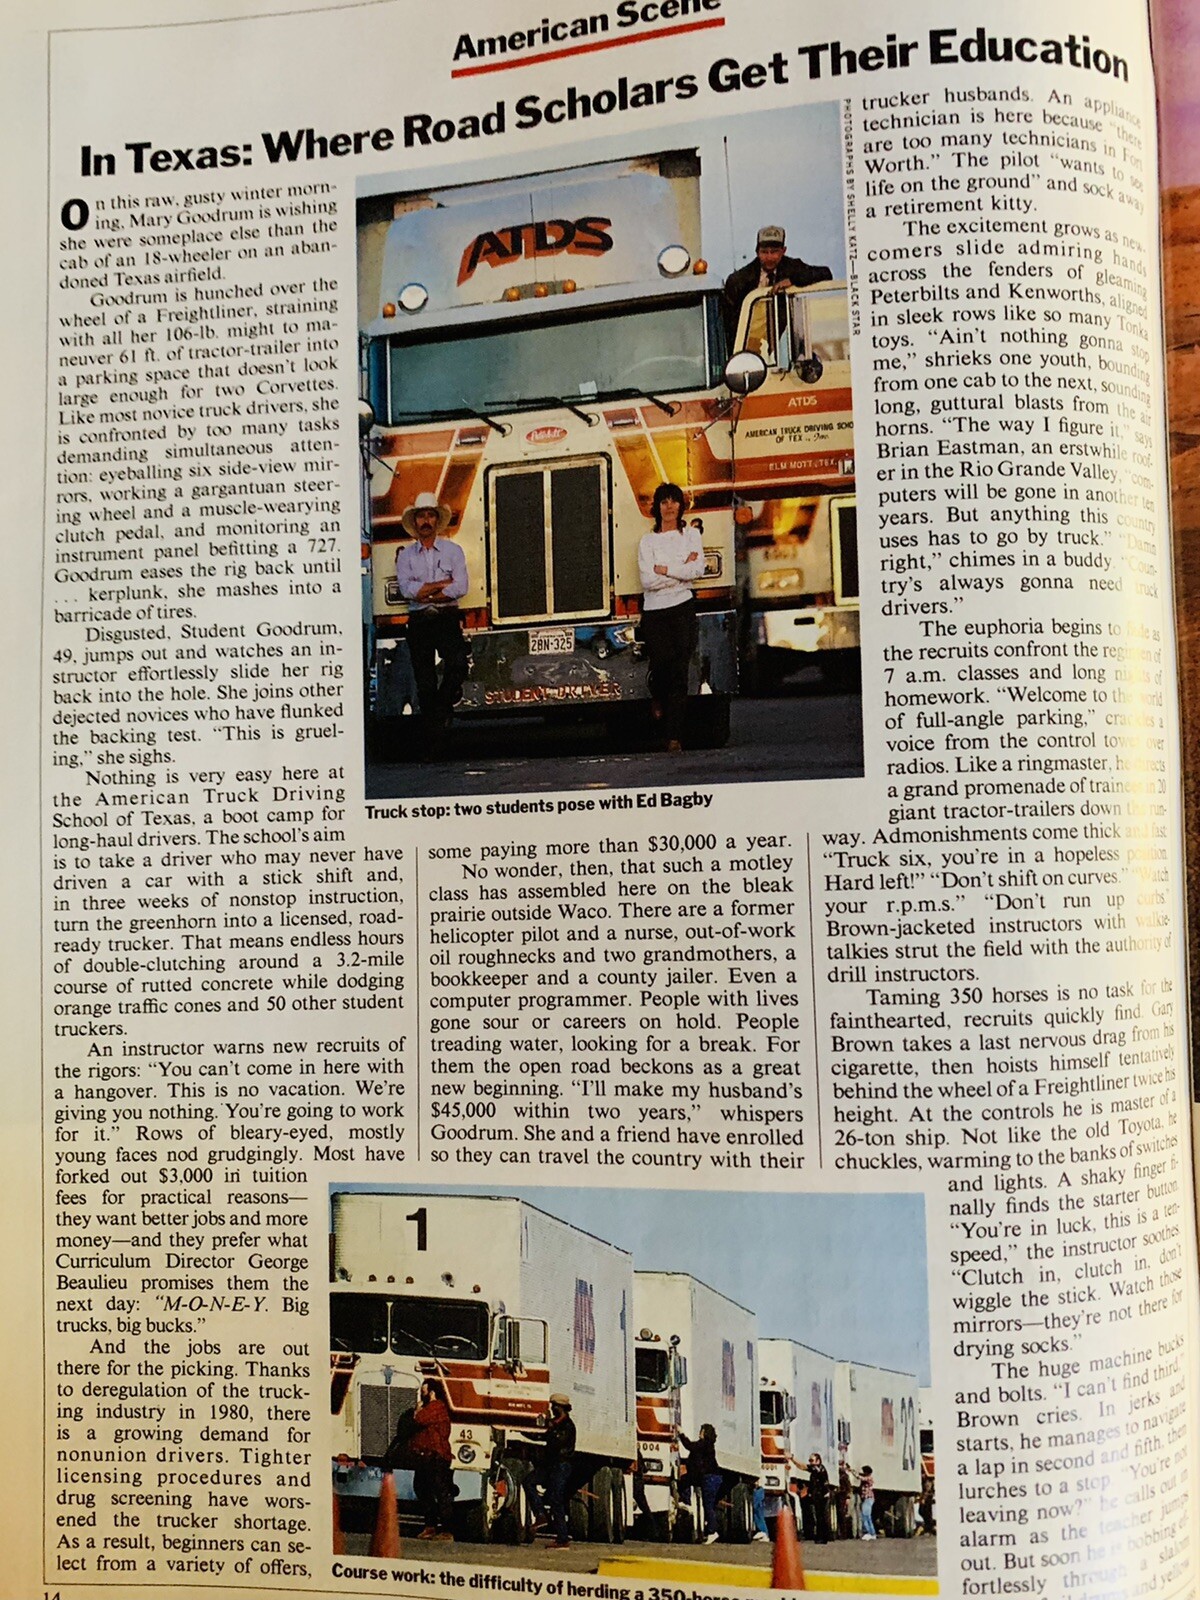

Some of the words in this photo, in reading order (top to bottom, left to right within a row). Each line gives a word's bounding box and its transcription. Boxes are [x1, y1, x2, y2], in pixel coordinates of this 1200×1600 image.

[453, 13, 609, 61] American
[617, 0, 722, 28] Scene
[81, 145, 115, 177] In
[125, 142, 252, 174] Texas:
[261, 128, 394, 164] Where
[404, 100, 505, 148] Road
[515, 74, 698, 129] Scholars
[708, 52, 789, 93] Get
[798, 33, 919, 79] Their
[929, 27, 1128, 83] Education
[844, 98, 854, 175] PHOTOGRAPHS
[846, 178, 855, 190] BY
[847, 194, 856, 231] SHELLY
[866, 207, 877, 218] a
[885, 197, 983, 217] retirement
[991, 196, 1037, 214] kitty.
[457, 216, 613, 286] ATDS
[59, 273, 108, 289] doned
[113, 272, 160, 286] Texas
[164, 266, 225, 284] airfield.
[869, 284, 960, 305] Peterbilts
[966, 283, 1000, 300] and
[1007, 282, 1105, 307] Kenworths,
[1110, 293, 1147, 319] aligned
[852, 310, 861, 336] STAR
[59, 354, 113, 367] neuver
[119, 350, 136, 364] 61
[145, 347, 160, 362] ft.
[167, 345, 184, 361] of
[189, 340, 301, 360] tractor-trailer
[307, 337, 339, 352] into
[788, 396, 817, 407] ATDS
[804, 423, 834, 433] DRIVING
[57, 446, 148, 464] demanding
[165, 443, 273, 459] simultaneous
[291, 439, 339, 452] atten-
[876, 442, 929, 459] Brian
[936, 439, 1025, 457] Eastman,
[1031, 442, 1053, 455] an
[1059, 442, 1127, 460] erstwhile
[56, 547, 144, 563] instrument
[154, 543, 199, 562] panel
[209, 540, 279, 558] befitting
[288, 543, 297, 554] a
[308, 538, 340, 553] 727.
[54, 606, 132, 623] barricade
[136, 604, 154, 620] of
[157, 607, 196, 619] tires.
[85, 625, 171, 644] Disgusted,
[181, 623, 246, 639] Student
[256, 621, 342, 637] Goodrum,
[53, 792, 82, 807] the
[95, 792, 189, 806] American
[203, 787, 259, 803] Truck
[272, 786, 345, 803] Driving
[364, 804, 408, 819] Truck
[411, 804, 450, 819] stop:
[454, 803, 482, 816] two
[486, 799, 554, 815] students
[557, 800, 595, 814] pose
[599, 794, 633, 810] with
[636, 793, 657, 808] Ed
[660, 791, 713, 809] Bagby
[888, 805, 937, 825] giant
[943, 800, 1075, 819] tractor-trailers
[1080, 800, 1121, 816] down
[428, 847, 471, 859] some
[480, 844, 537, 861] paying
[546, 842, 590, 855] more
[599, 837, 639, 854] than
[648, 834, 717, 854] $30,000
[726, 837, 737, 849] a
[746, 835, 791, 852] year.
[54, 919, 89, 932] turn
[96, 916, 123, 931] the
[129, 914, 217, 934] greenhorn
[223, 914, 257, 928] into
[263, 915, 273, 927] a
[280, 910, 352, 927] licensed,
[359, 908, 403, 924] road-
[827, 966, 867, 983] drill
[875, 967, 979, 982] instructors.
[54, 1021, 127, 1036] truckers.
[830, 1011, 951, 1031] fainthearted,
[964, 1011, 1033, 1027] recruits
[1044, 1006, 1104, 1028] quickly
[431, 1036, 502, 1055] treading
[509, 1037, 563, 1054] water,
[571, 1035, 638, 1055] looking
[646, 1035, 671, 1052] for
[679, 1039, 690, 1052] a
[698, 1035, 756, 1052] break.
[766, 1036, 800, 1053] For
[948, 1175, 984, 1192] and
[994, 1173, 1047, 1194] lights.
[1057, 1171, 1072, 1188] A
[1081, 1166, 1126, 1186] shaky
[1134, 1161, 1166, 1180] finger
[406, 1208, 427, 1251] 1
[55, 1253, 151, 1269] Curriculum
[165, 1253, 235, 1269] Director
[248, 1253, 309, 1273] George
[56, 1298, 93, 1311] next
[106, 1295, 140, 1314] day:
[282, 1297, 309, 1316] Big
[956, 1411, 1019, 1428] Brown
[1036, 1409, 1082, 1425] cries.
[1099, 1401, 1114, 1417] In
[1128, 1391, 1160, 1415] jerks
[460, 1430, 473, 1440] 43
[57, 1555, 87, 1571] lect
[97, 1554, 137, 1571] from
[146, 1559, 156, 1571] a
[166, 1559, 225, 1576] variety
[234, 1557, 253, 1574] of
[260, 1558, 312, 1579] offers,
[332, 1562, 388, 1581] Course
[391, 1568, 435, 1584] work:
[439, 1571, 466, 1587] the
[469, 1573, 543, 1596] difficulty
[546, 1580, 564, 1595] of
[567, 1581, 631, 1600] herding
[634, 1590, 644, 1600] a
